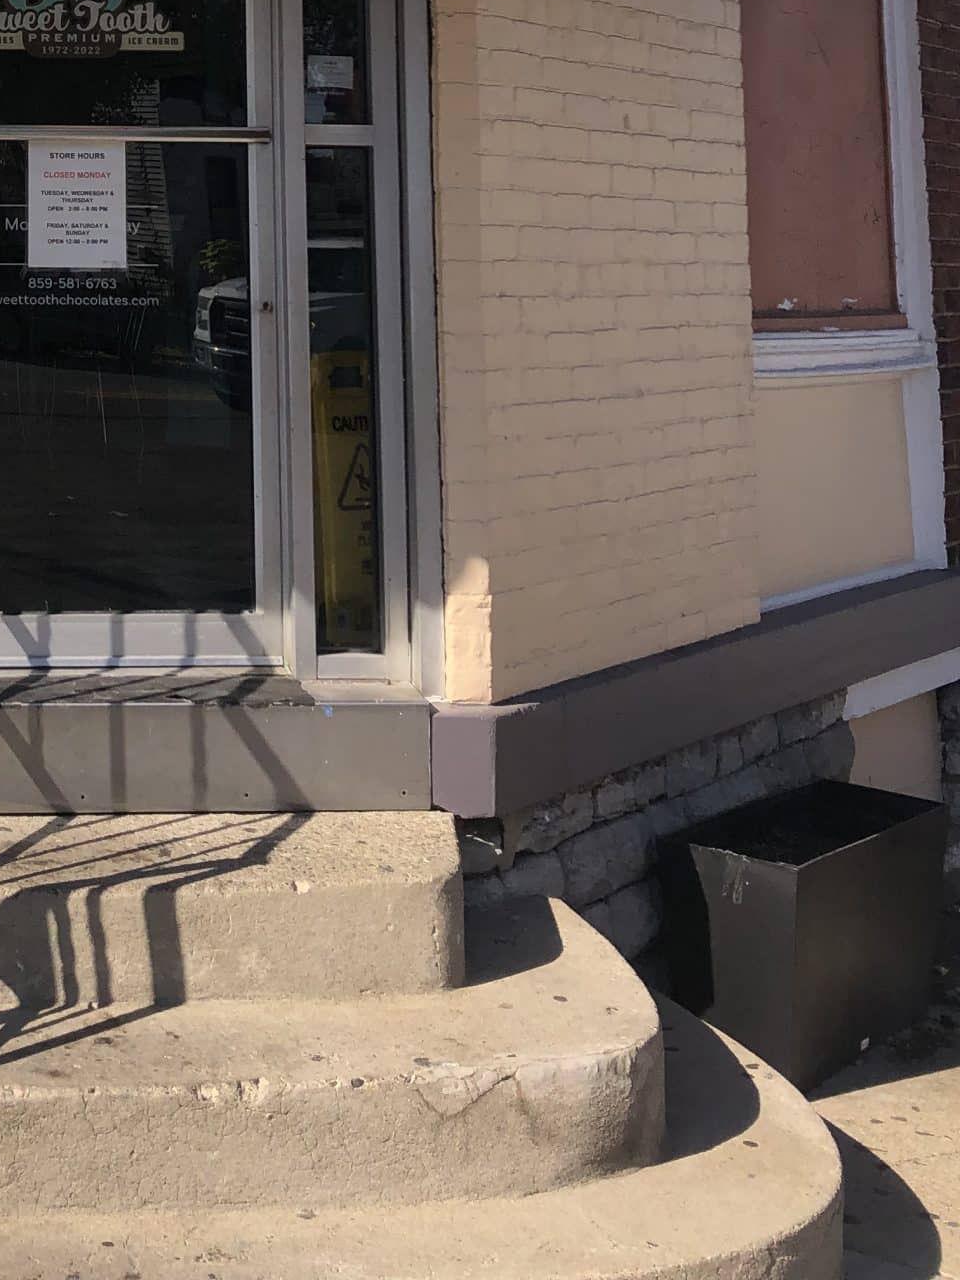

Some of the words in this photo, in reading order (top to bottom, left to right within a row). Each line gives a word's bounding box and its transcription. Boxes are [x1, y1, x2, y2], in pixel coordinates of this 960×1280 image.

[74, 0, 171, 33] Tooth
[27, 32, 117, 43] PREMIUM
[127, 36, 143, 46] ICE
[146, 36, 180, 46] CREAM
[41, 46, 102, 56] 1972-2022
[49, 152, 75, 160] STORE
[77, 152, 105, 160] HOURS
[43, 171, 75, 179] CLOSED
[77, 171, 112, 179] MONDAY
[28, 277, 117, 289] 859-581-6763
